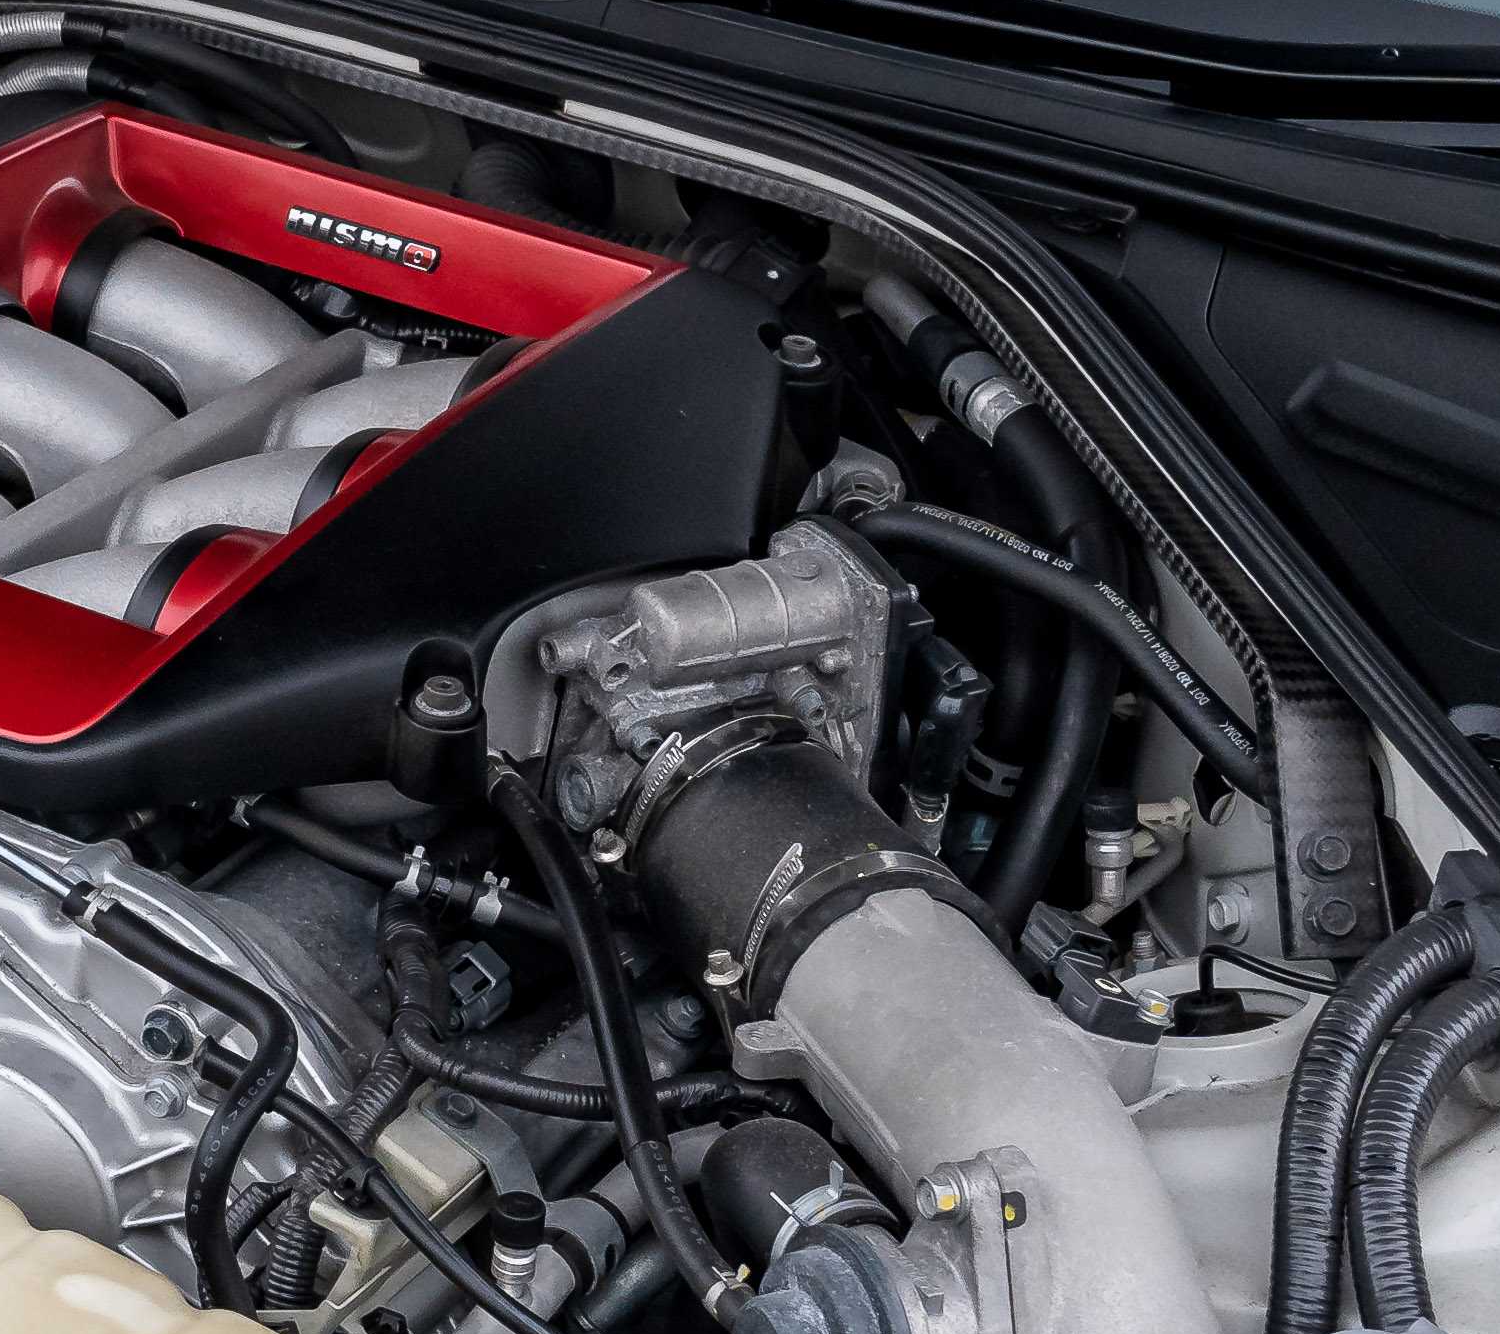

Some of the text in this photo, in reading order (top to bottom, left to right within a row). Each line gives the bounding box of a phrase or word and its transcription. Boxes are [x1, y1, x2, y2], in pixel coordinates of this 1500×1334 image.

[286, 208, 438, 272] nismo
[1052, 557, 1074, 571] DOT
[1150, 641, 1180, 672] 020814
[1188, 687, 1210, 706] DOT
